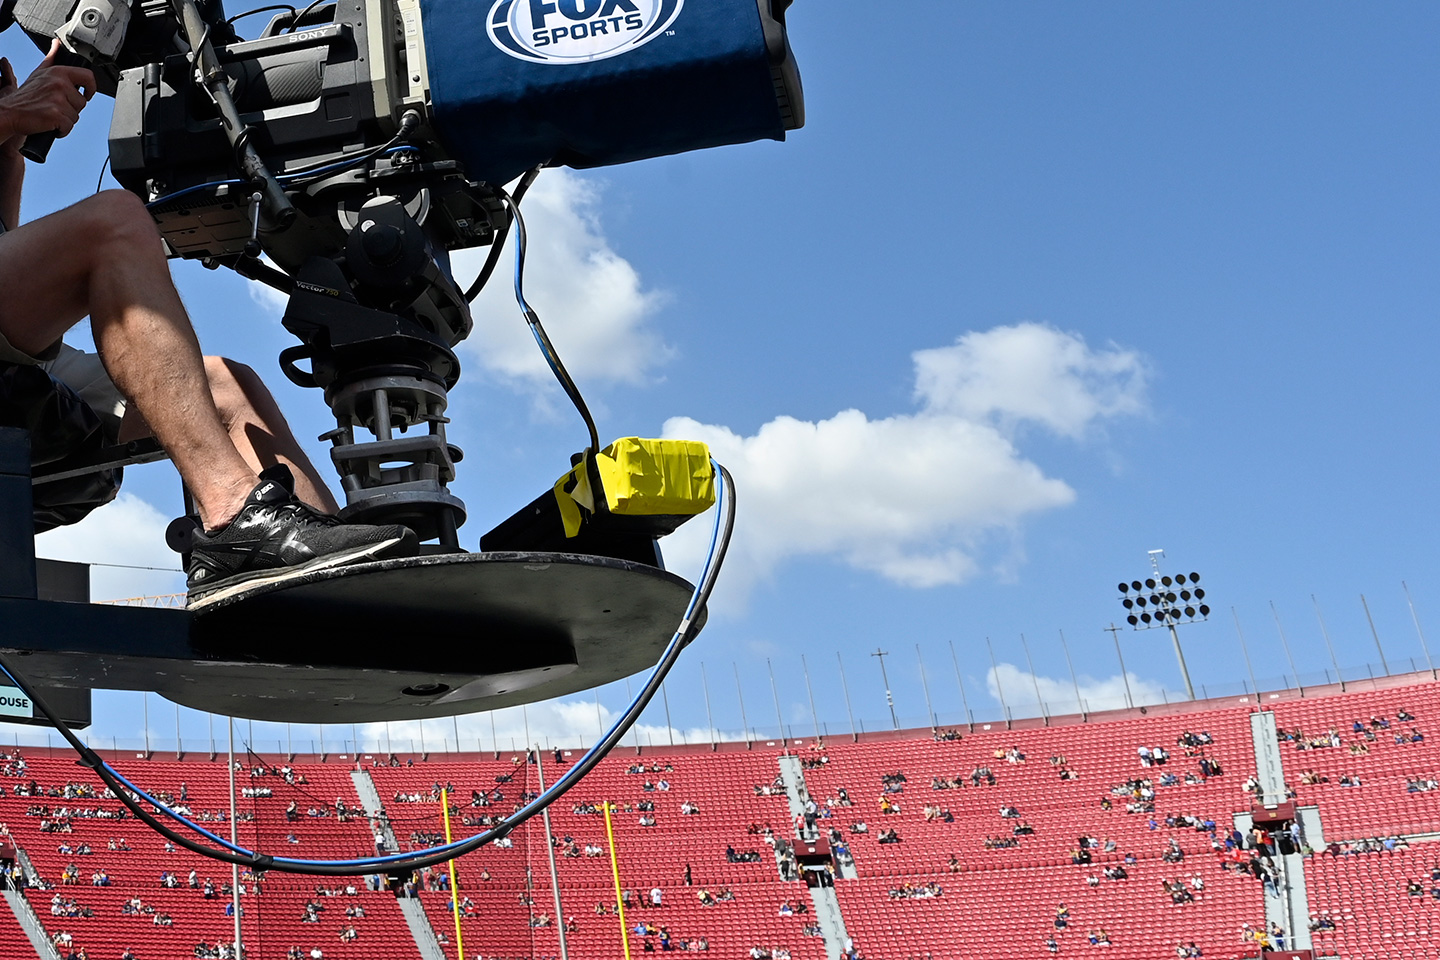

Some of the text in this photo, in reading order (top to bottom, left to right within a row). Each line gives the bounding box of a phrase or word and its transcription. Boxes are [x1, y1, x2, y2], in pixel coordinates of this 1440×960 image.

[289, 30, 328, 43] SONY
[532, 13, 644, 48] SPORTS
[296, 280, 325, 293] Vector
